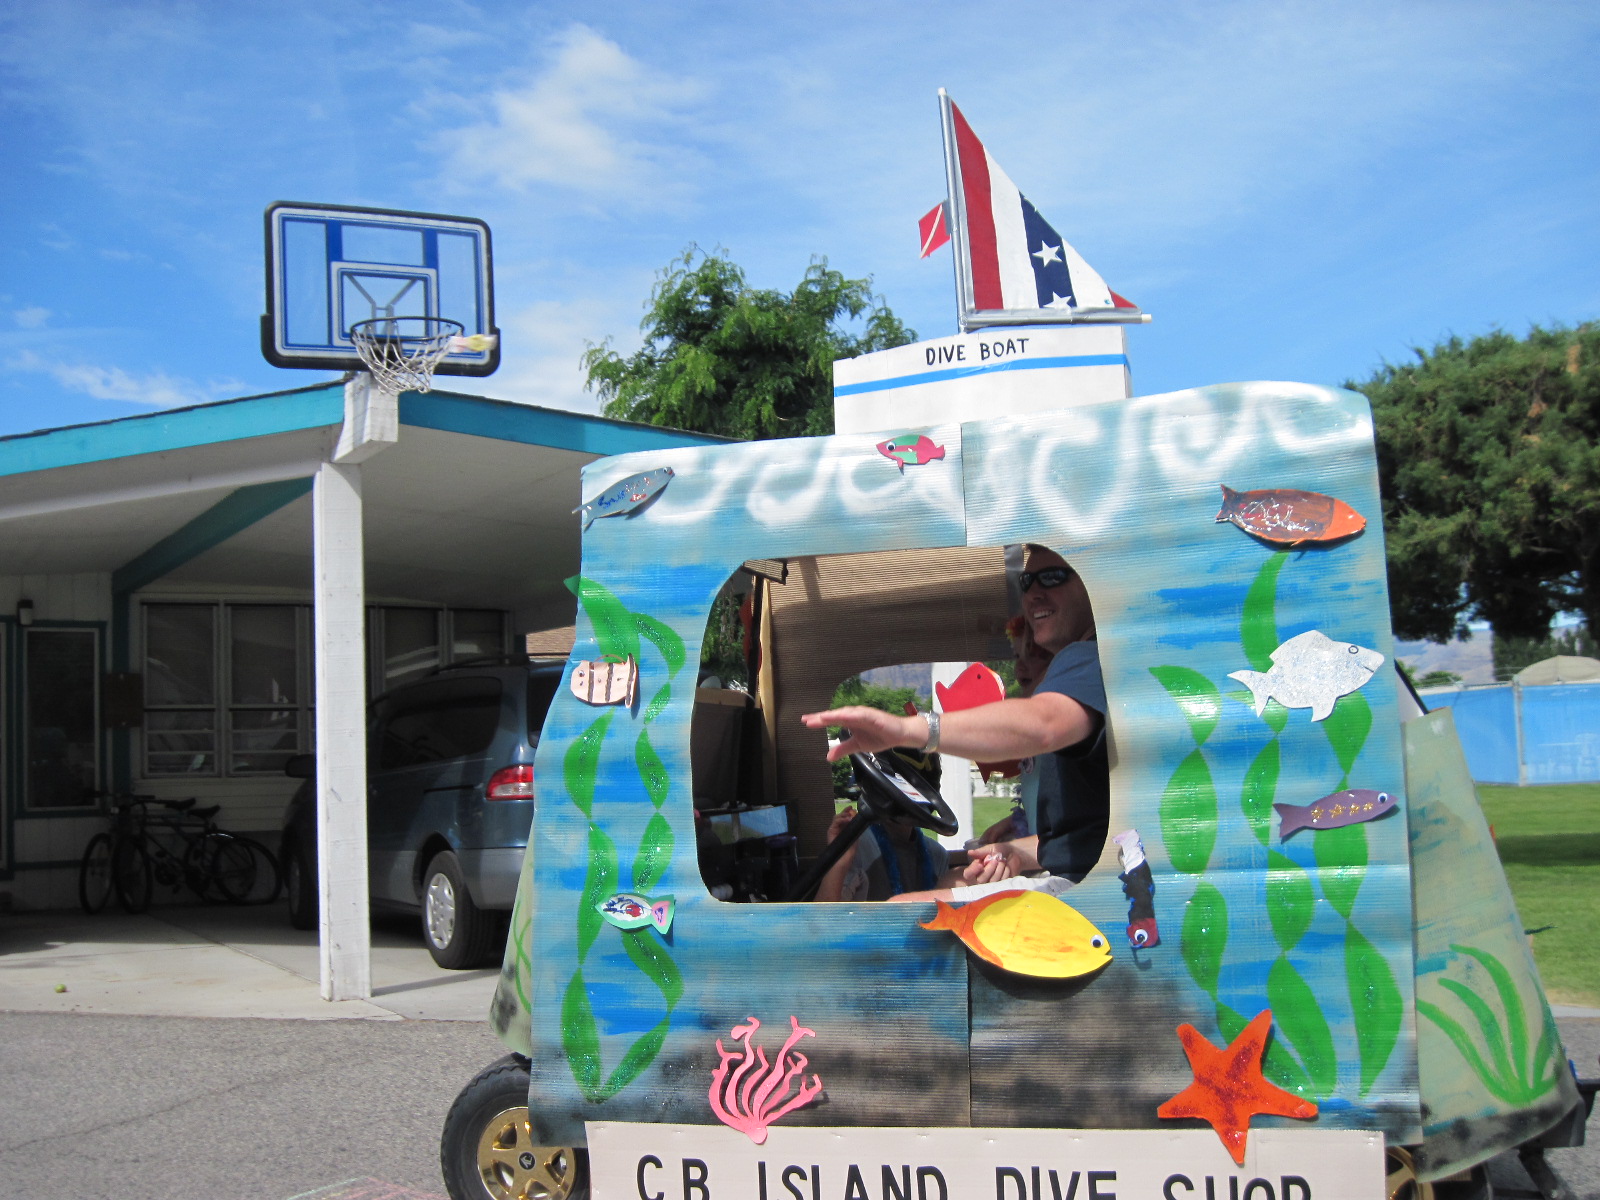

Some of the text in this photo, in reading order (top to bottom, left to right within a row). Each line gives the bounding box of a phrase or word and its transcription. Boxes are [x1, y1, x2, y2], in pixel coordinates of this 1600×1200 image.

[925, 338, 1030, 366] DIVE BOAT
[757, 1160, 948, 1200] ISLAND
[995, 1165, 1117, 1200] DIVE
